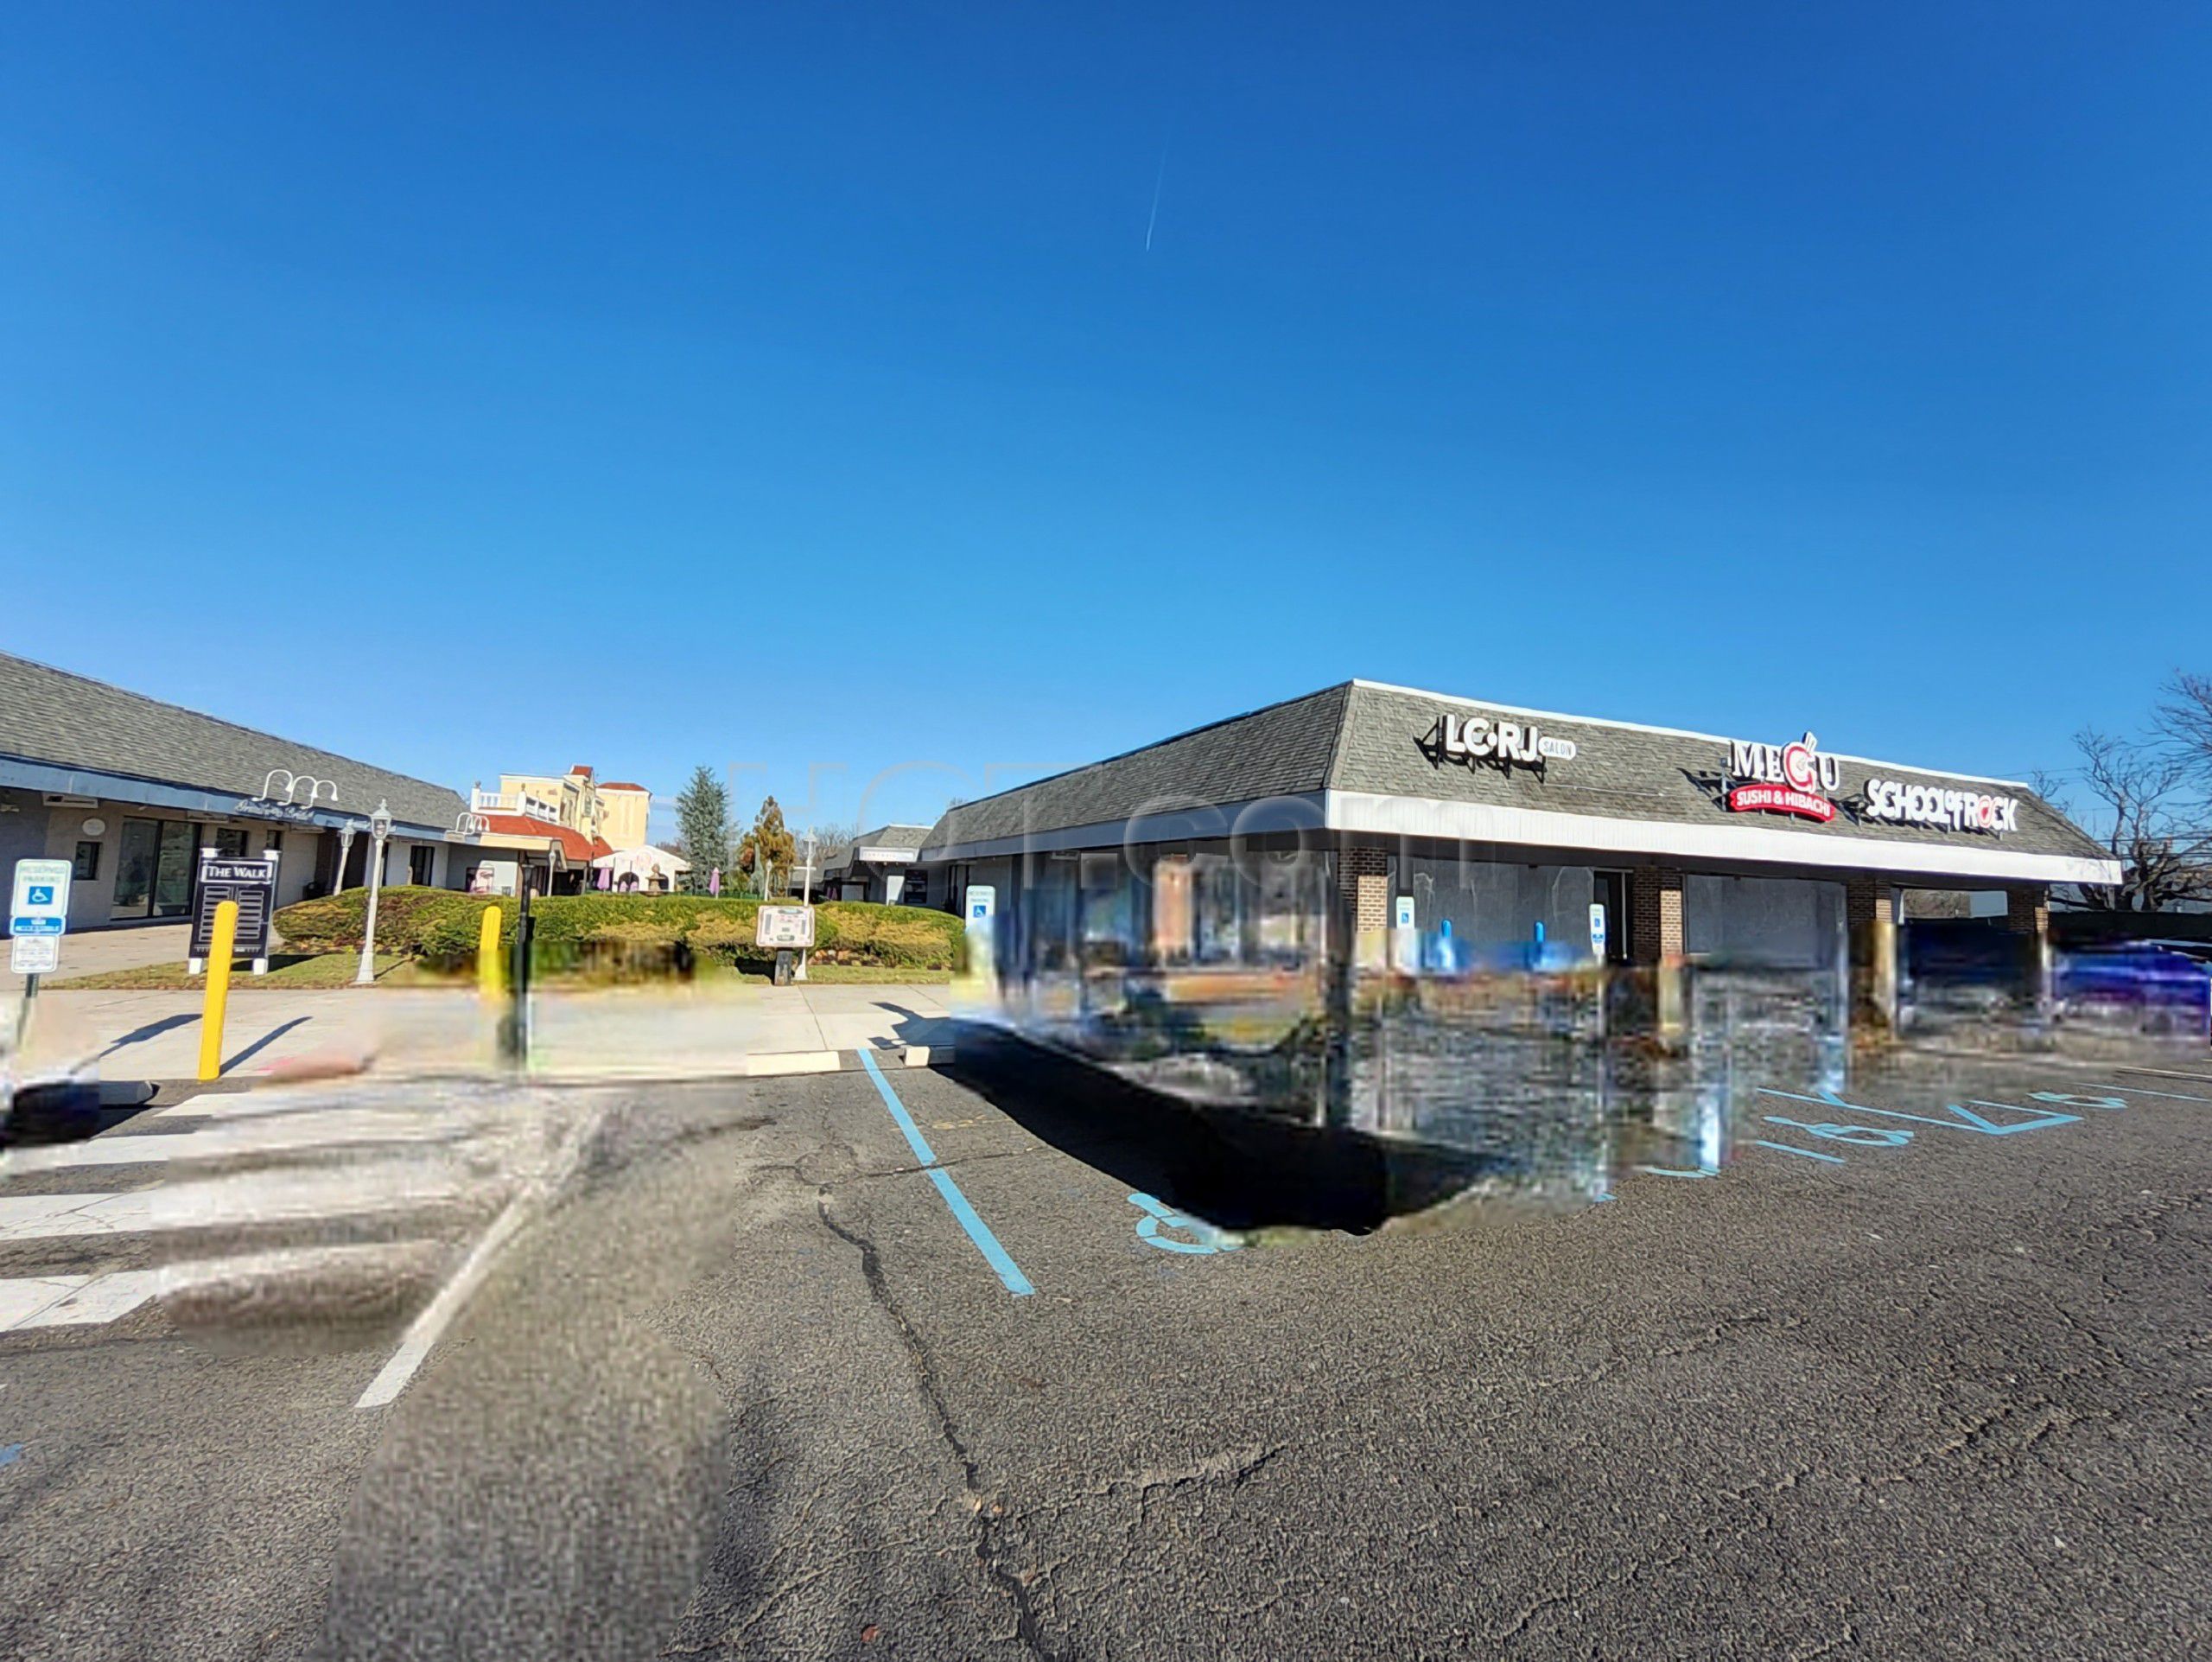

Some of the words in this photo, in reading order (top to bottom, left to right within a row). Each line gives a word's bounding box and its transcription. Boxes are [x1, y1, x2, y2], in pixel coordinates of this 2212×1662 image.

[1543, 740, 1572, 757] SALON
[1732, 741, 1840, 794] MEGU
[1736, 789, 1772, 807] SUSHI
[1773, 790, 1784, 806] &
[1785, 792, 1831, 818] HIBACHI
[1866, 779, 1950, 824] SCHOOL
[1963, 792, 2018, 831] ROCK
[207, 865, 232, 878] THE
[233, 866, 266, 879] WALK
